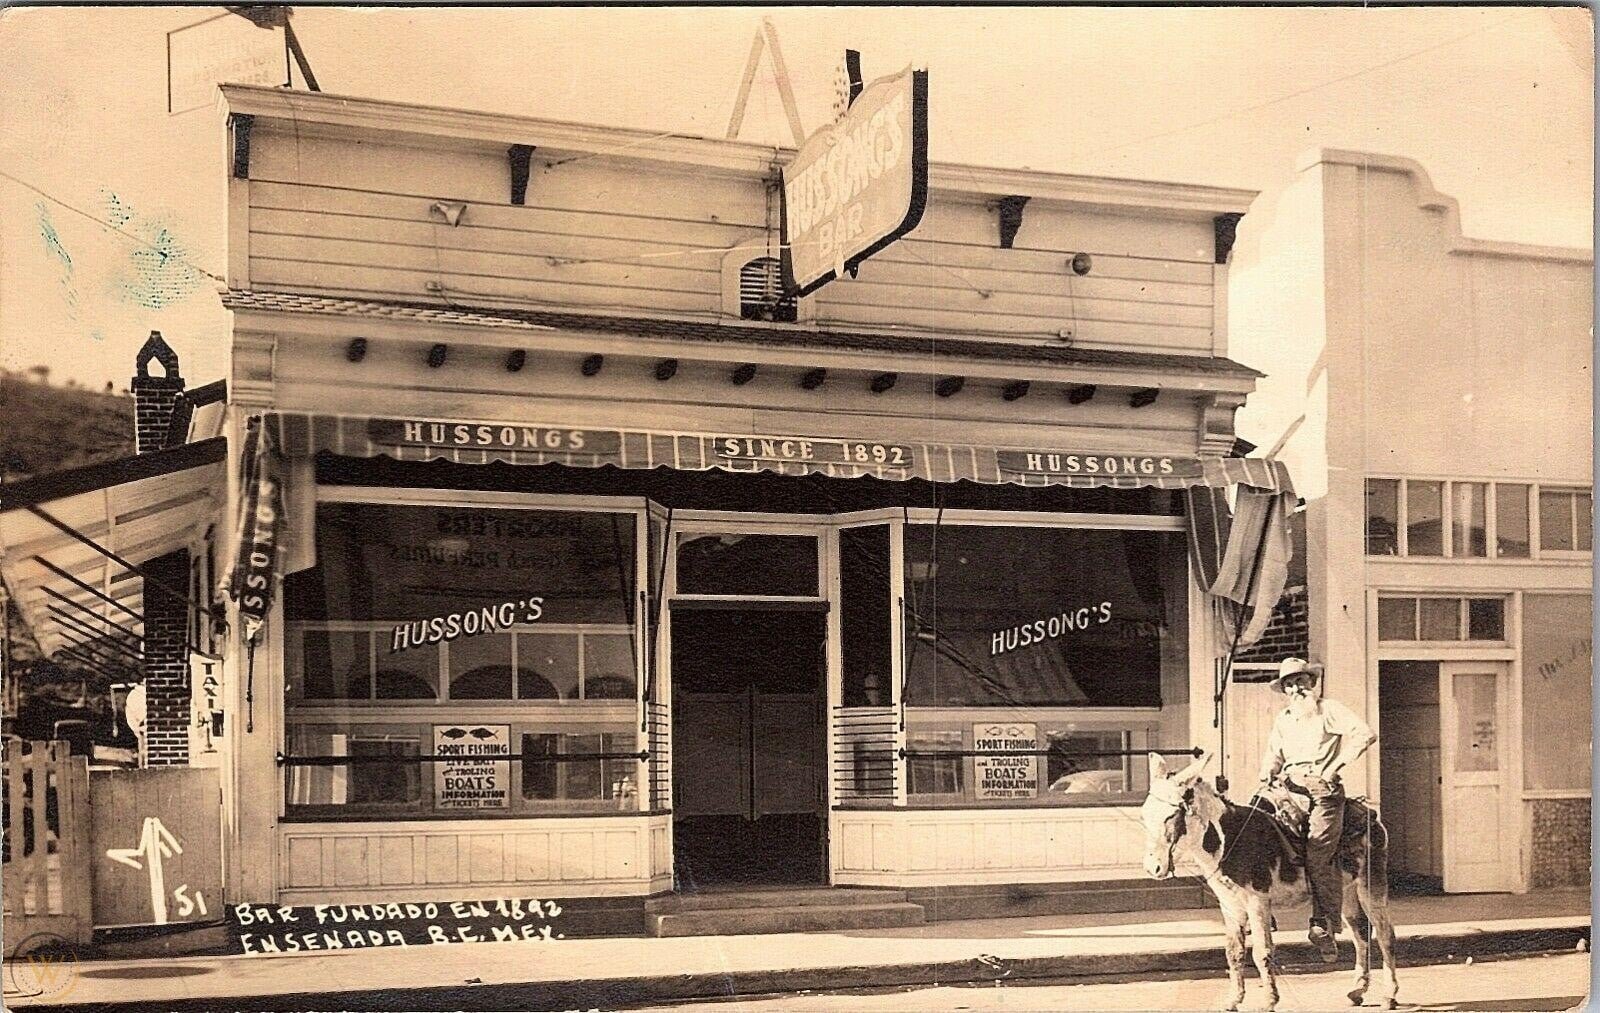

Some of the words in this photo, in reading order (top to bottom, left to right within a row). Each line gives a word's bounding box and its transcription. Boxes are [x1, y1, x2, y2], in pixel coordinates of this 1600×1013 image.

[819, 202, 863, 258] BAR
[404, 421, 585, 449] HUSSONGS
[724, 438, 814, 460] SINCE
[843, 442, 905, 464] 1892
[1026, 453, 1174, 475] HUSSONGS
[392, 597, 545, 651] HUSSONG'S
[991, 601, 1112, 655] HUSSONG'S
[201, 662, 218, 709] TAXI
[437, 744, 465, 755] SPORT
[468, 743, 508, 755] FISHING
[976, 739, 1003, 750] SPORT
[1004, 739, 1036, 750] FISHING
[454, 767, 496, 776] TROLING
[985, 767, 1027, 779] BOATS
[990, 758, 1030, 767] TROLING
[445, 776, 496, 790] BOATS
